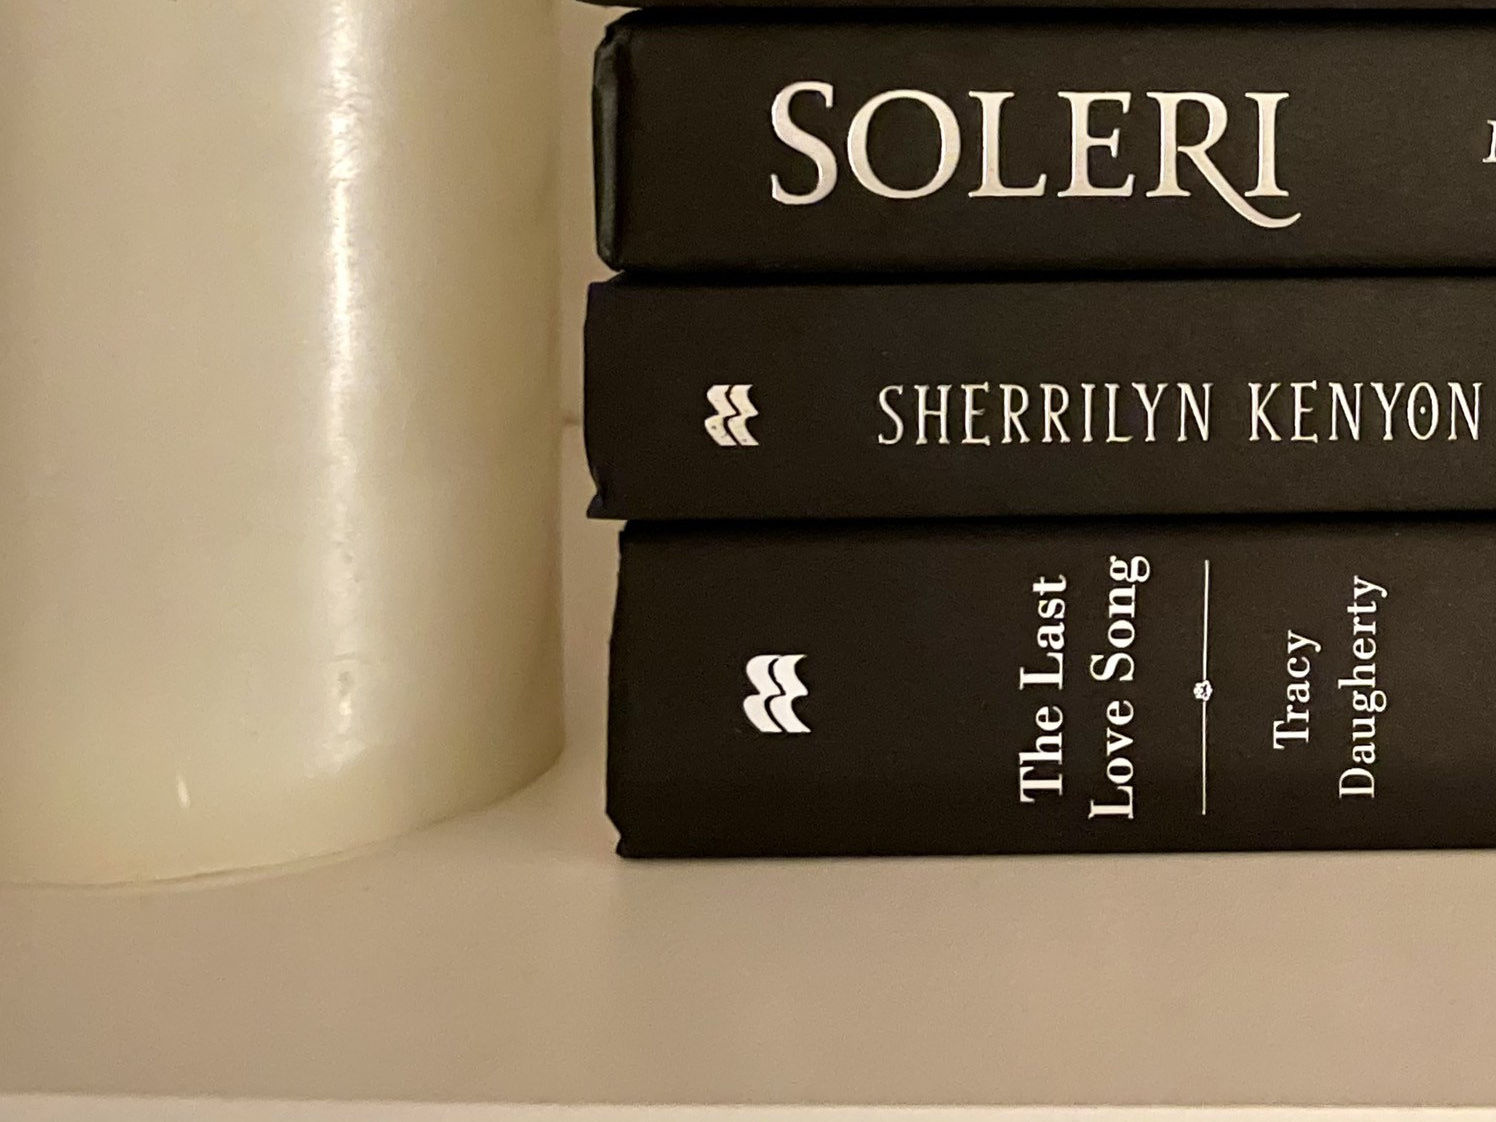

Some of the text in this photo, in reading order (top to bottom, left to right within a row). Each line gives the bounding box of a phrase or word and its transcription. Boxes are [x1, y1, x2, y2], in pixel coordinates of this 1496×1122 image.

[771, 81, 1301, 228] SOLERI
[876, 380, 1482, 446] SHERRILYN KENYON
[1017, 573, 1067, 803] The Last
[1087, 554, 1151, 820] Love Song
[1273, 630, 1321, 750] Tracy
[1338, 575, 1387, 798] Daugherty
